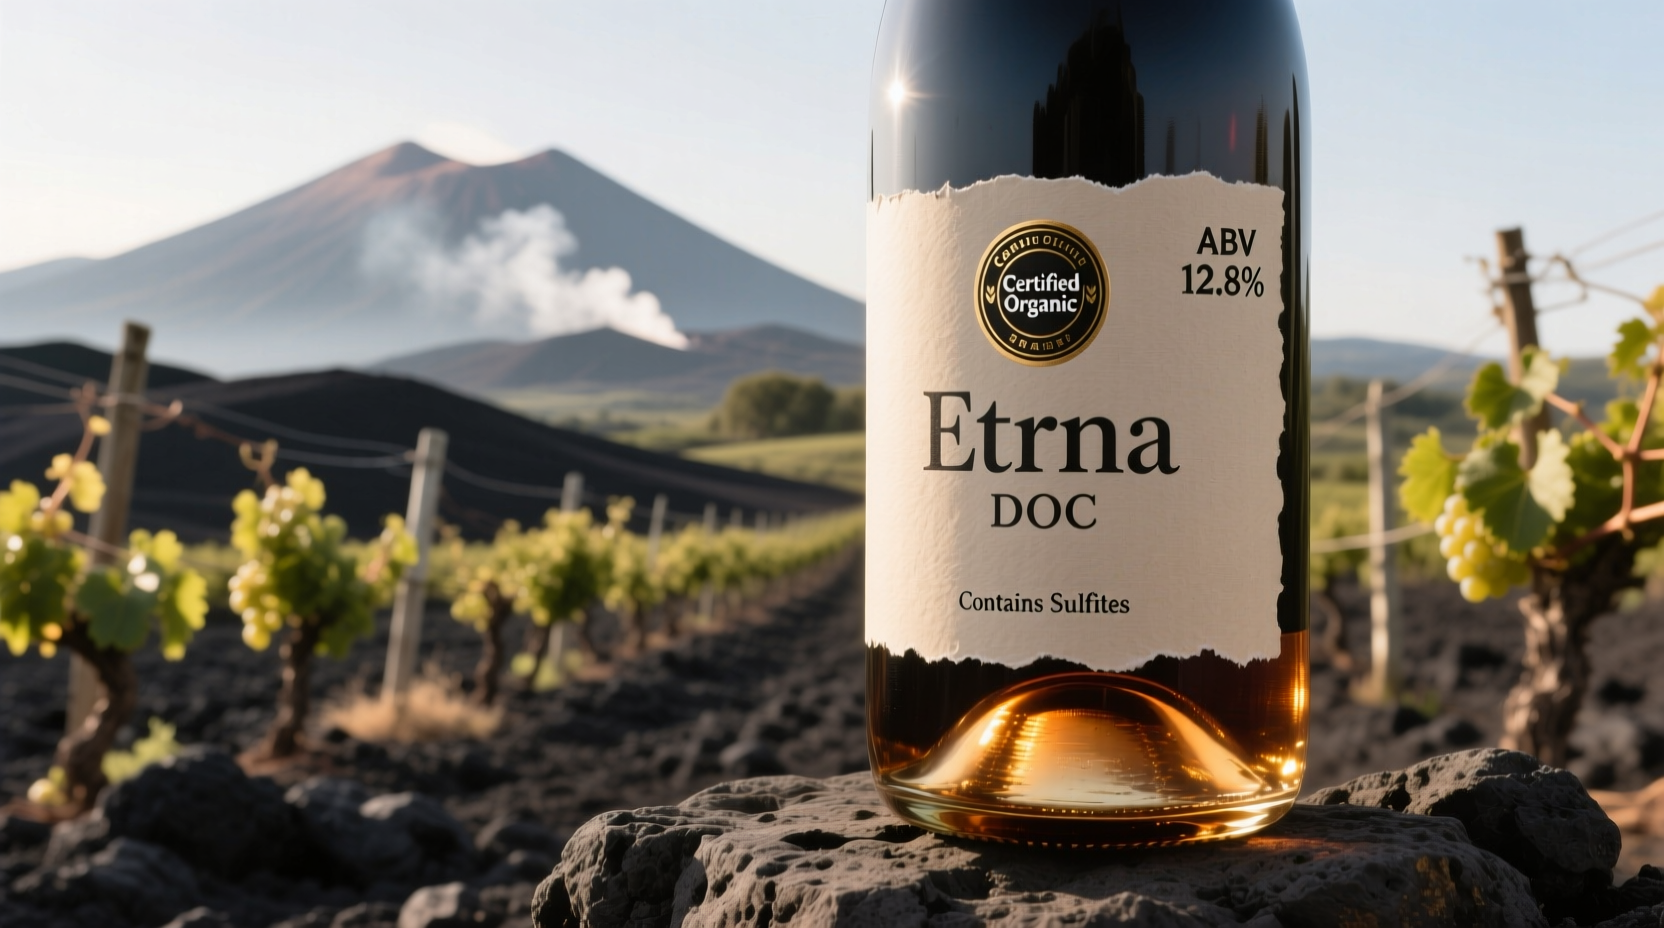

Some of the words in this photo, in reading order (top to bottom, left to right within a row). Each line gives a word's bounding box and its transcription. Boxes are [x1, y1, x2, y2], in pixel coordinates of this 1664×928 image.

[1196, 226, 1257, 257] ABV
[1002, 272, 1081, 293] Certified
[1181, 263, 1265, 298] 12.8%
[1003, 294, 1078, 318] Organic
[923, 390, 1181, 476] Etrna
[991, 493, 1097, 530] DOC
[958, 590, 1044, 613] Contains
[1050, 591, 1131, 615] Sulfites
